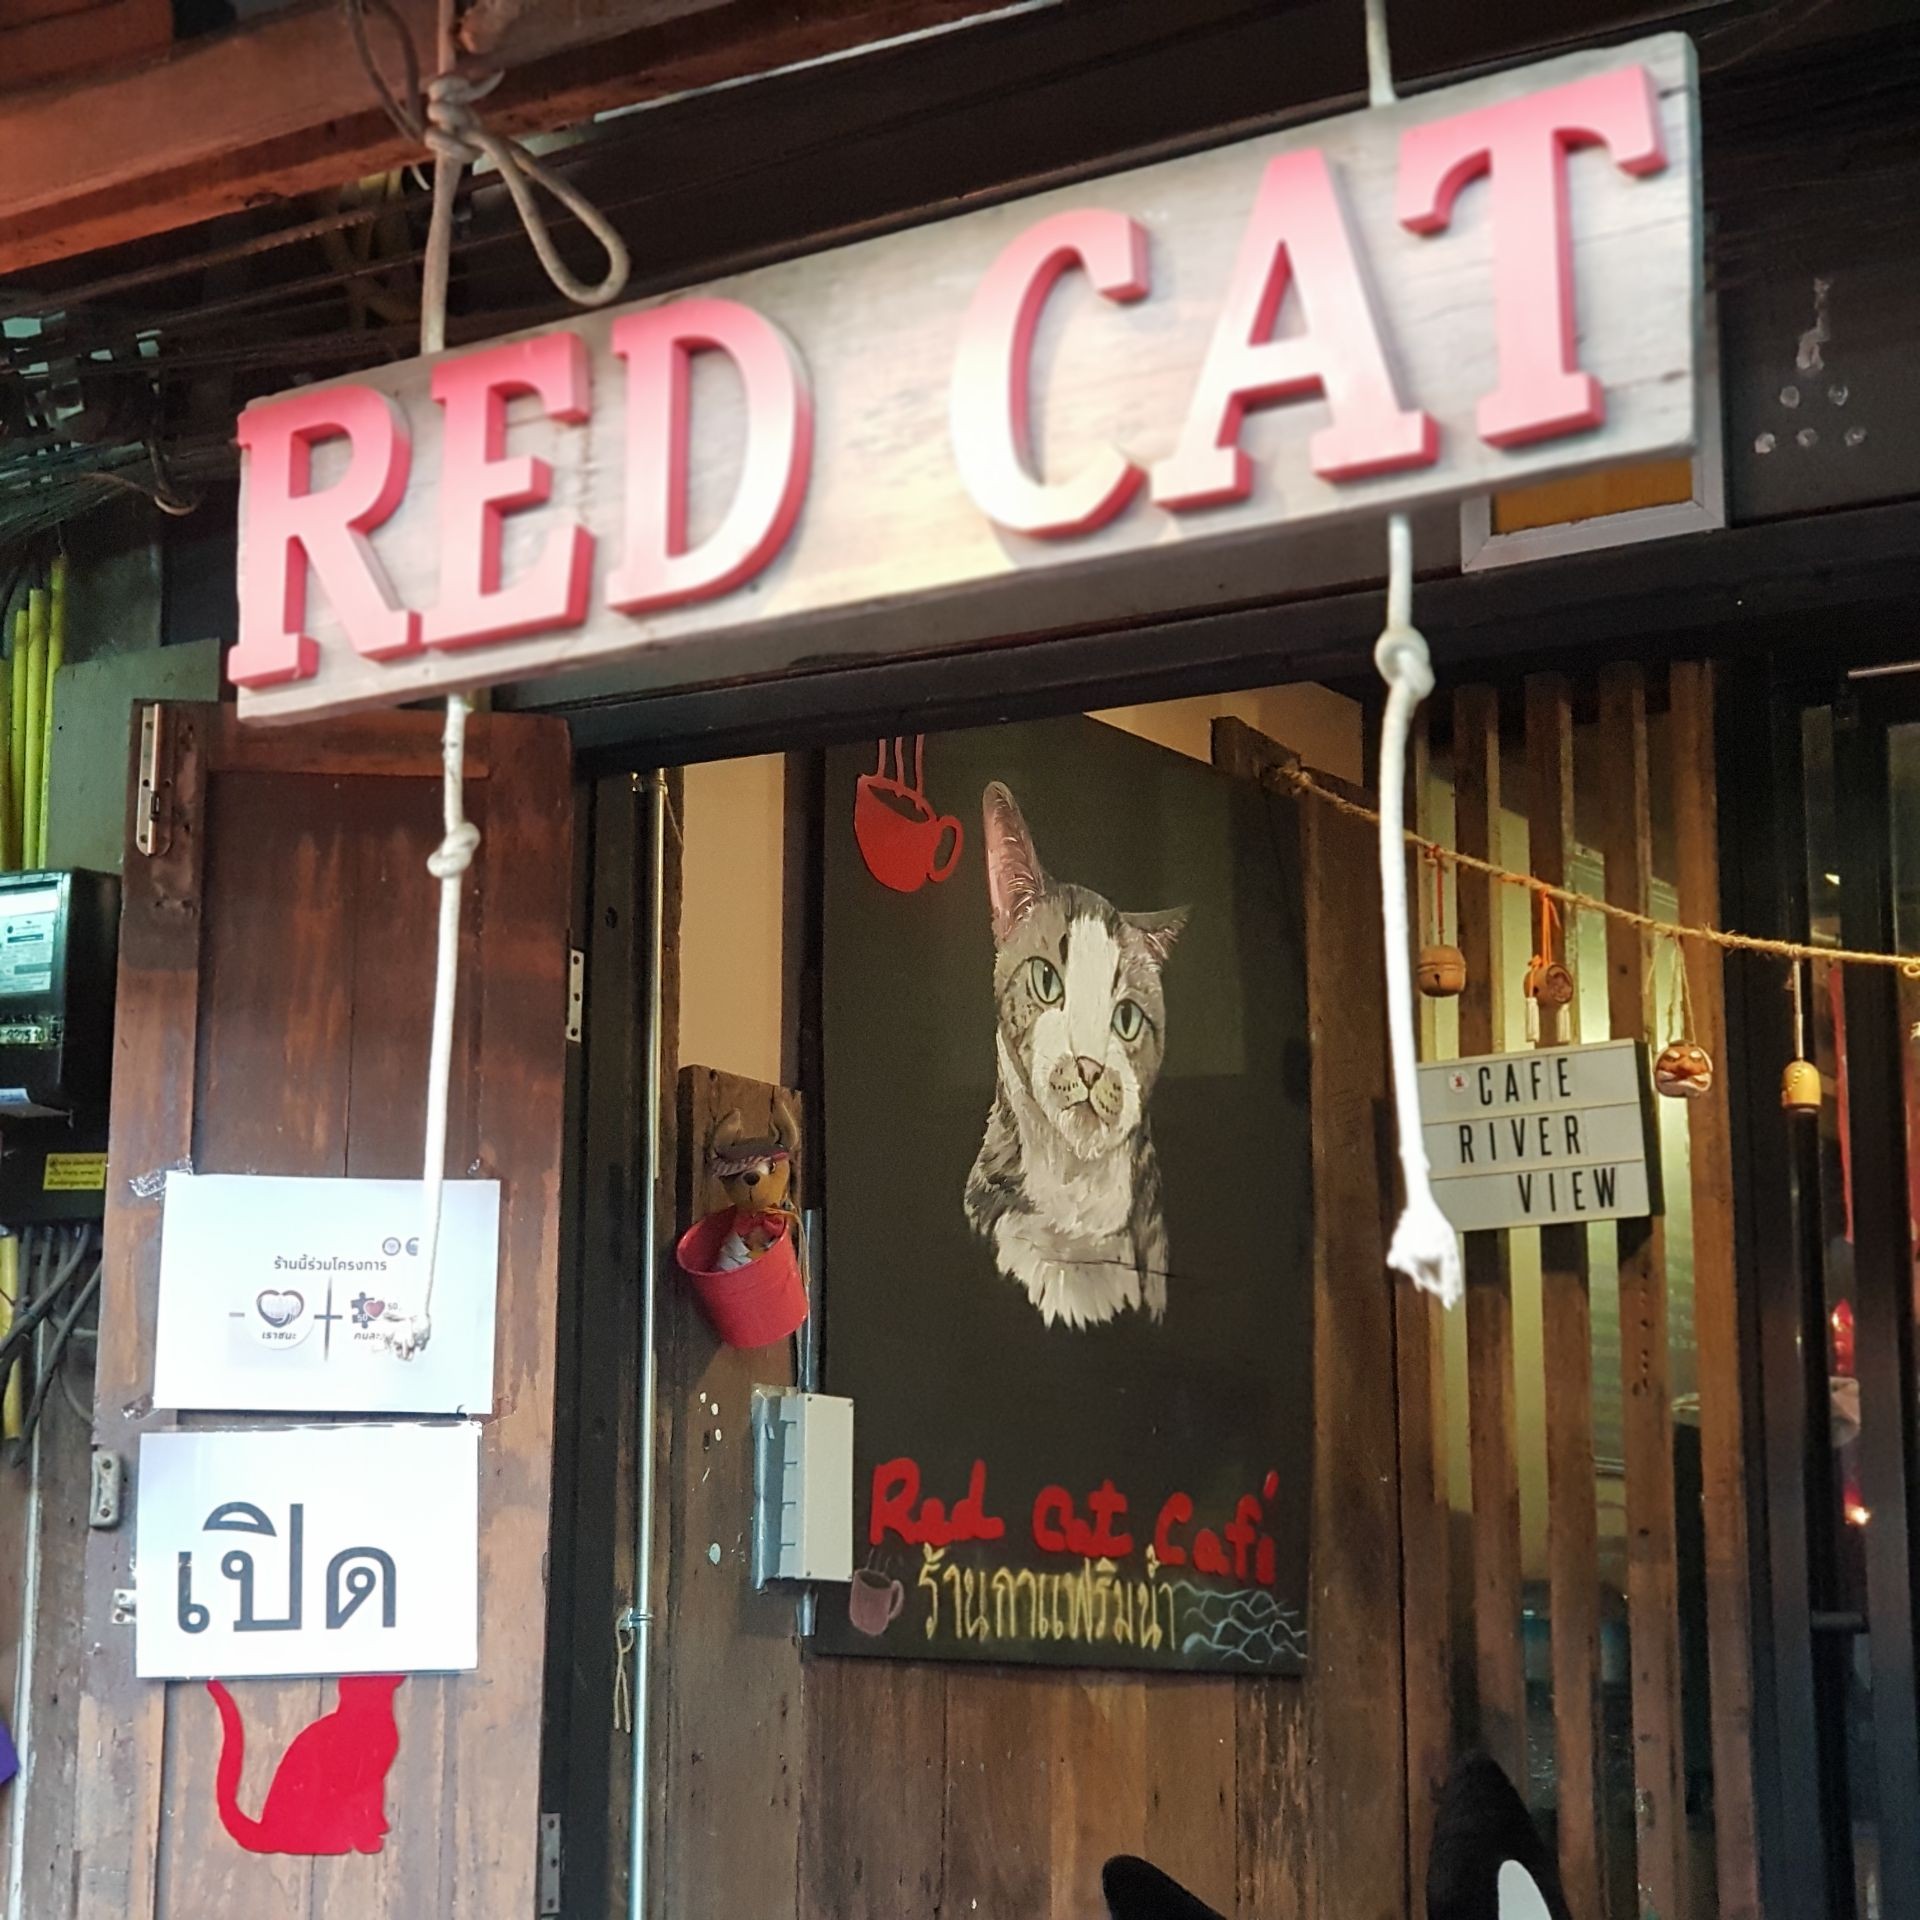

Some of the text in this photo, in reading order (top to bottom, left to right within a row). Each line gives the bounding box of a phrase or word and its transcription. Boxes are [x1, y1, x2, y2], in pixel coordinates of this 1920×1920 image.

[227, 63, 1669, 690] RED CAT
[1478, 1057, 1572, 1106] CAFE
[1458, 1114, 1581, 1164] RIVER
[1517, 1166, 1616, 1214] VIEW
[274, 1253, 388, 1272] ร้านนี้ร่วมโครงการ
[869, 1457, 1005, 1546] Red
[1032, 1478, 1134, 1558] Cat
[177, 1501, 397, 1634] เปิด
